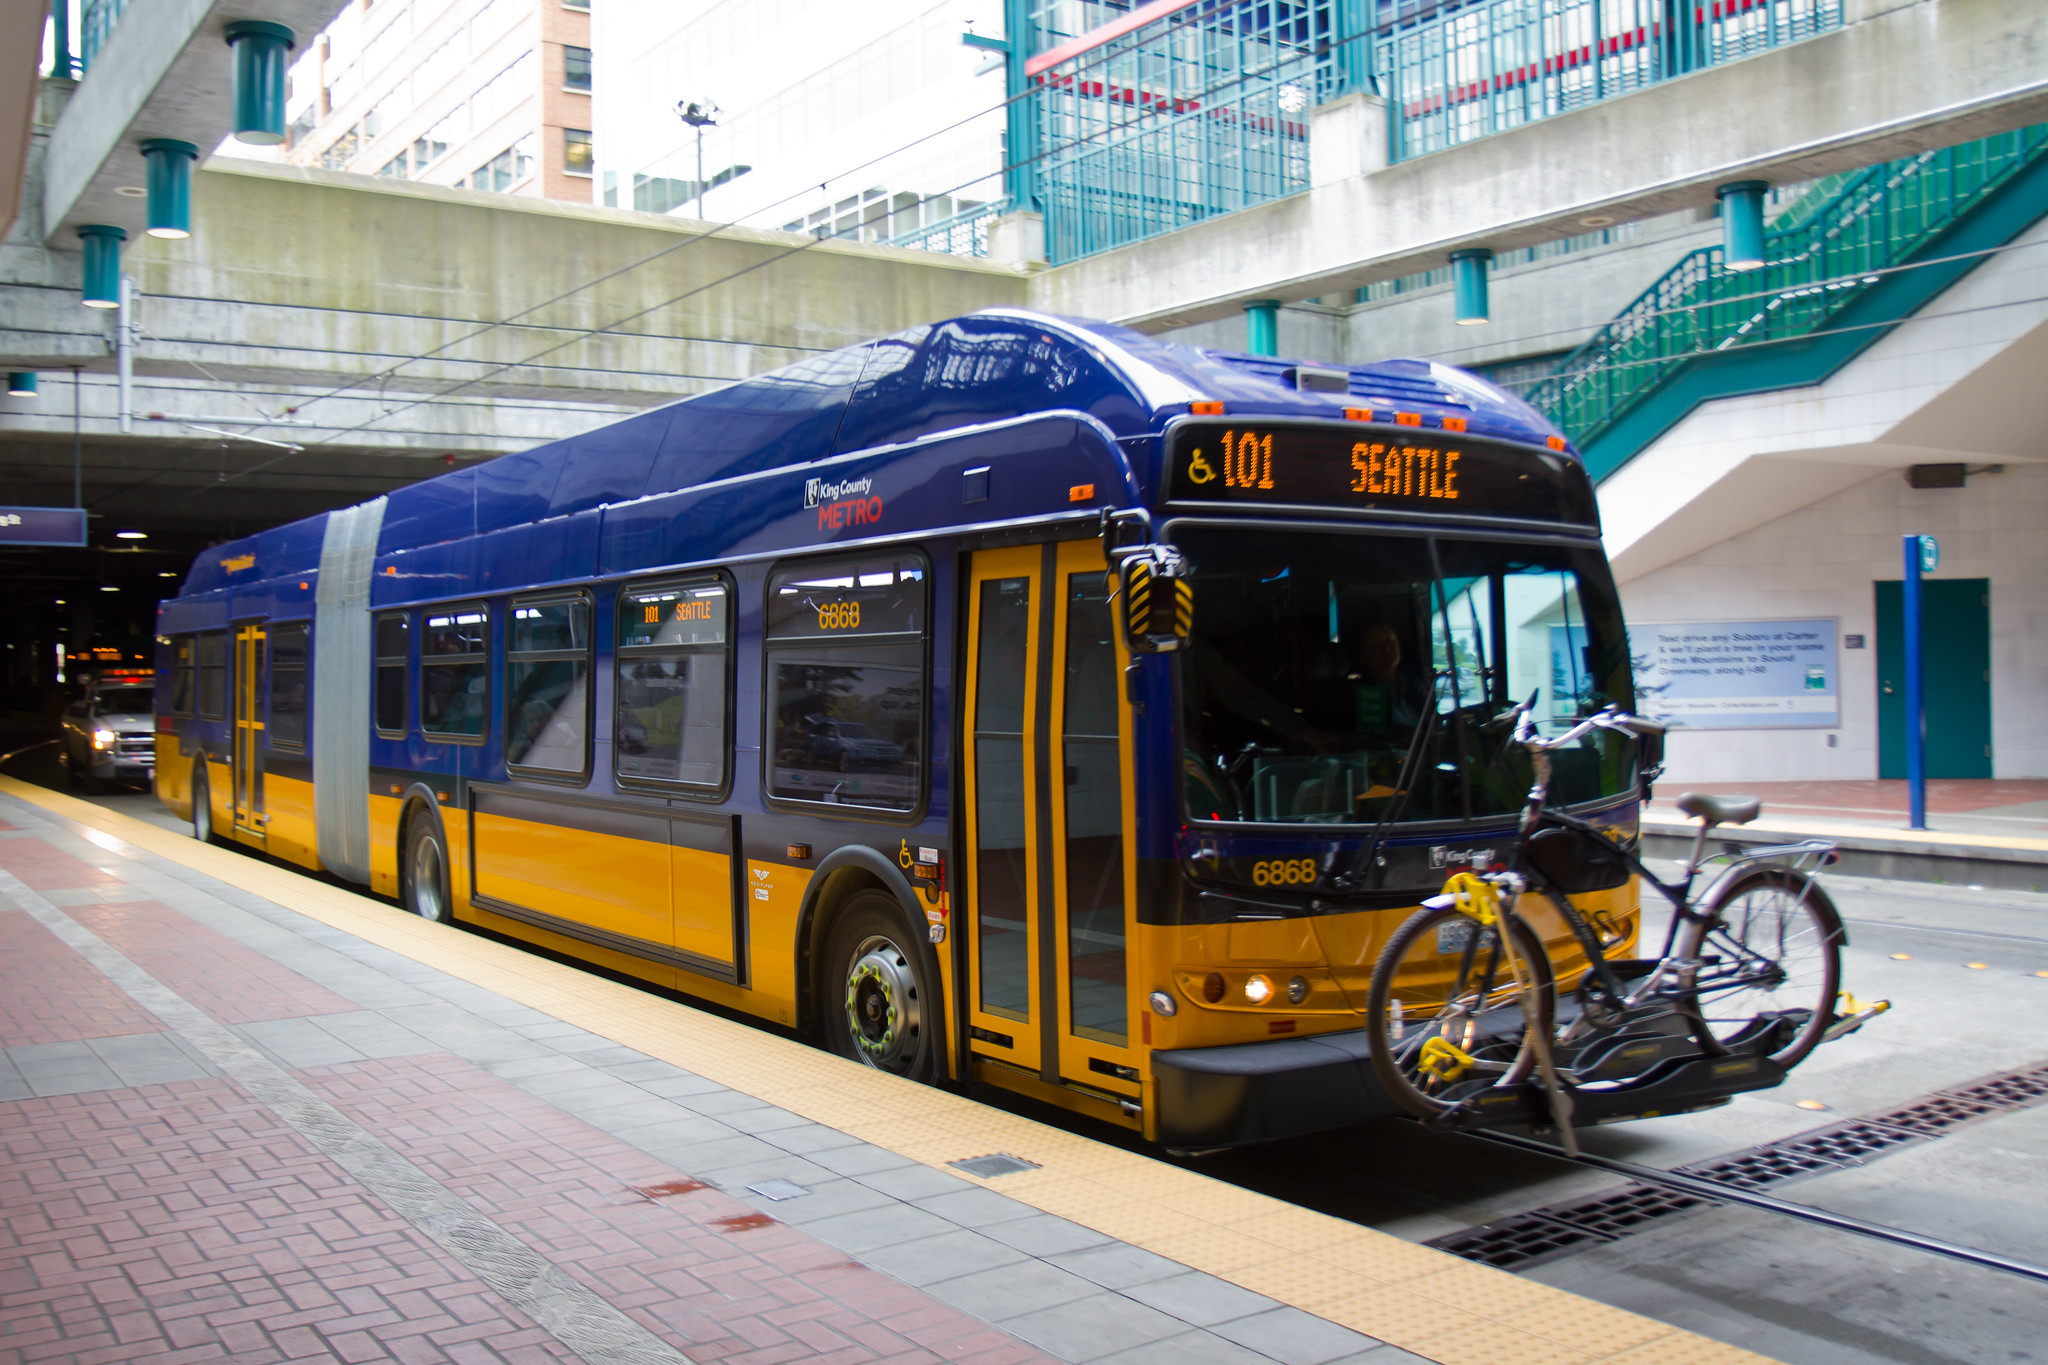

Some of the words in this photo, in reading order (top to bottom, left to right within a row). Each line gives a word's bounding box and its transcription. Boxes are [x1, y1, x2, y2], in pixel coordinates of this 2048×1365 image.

[1220, 430, 1274, 490] 101
[1350, 442, 1461, 498] SEATTLE
[820, 482, 840, 500] King
[840, 477, 873, 495] County
[818, 495, 883, 531] METRO
[644, 605, 659, 623] 101
[676, 601, 711, 621] SEATTLE
[818, 601, 861, 629] 6868
[1732, 633, 1770, 641] Subaru
[1760, 654, 1795, 662] Sound
[1446, 850, 1466, 863] King
[1252, 857, 1317, 887] 6868
[928, 911, 941, 920] RAMP
